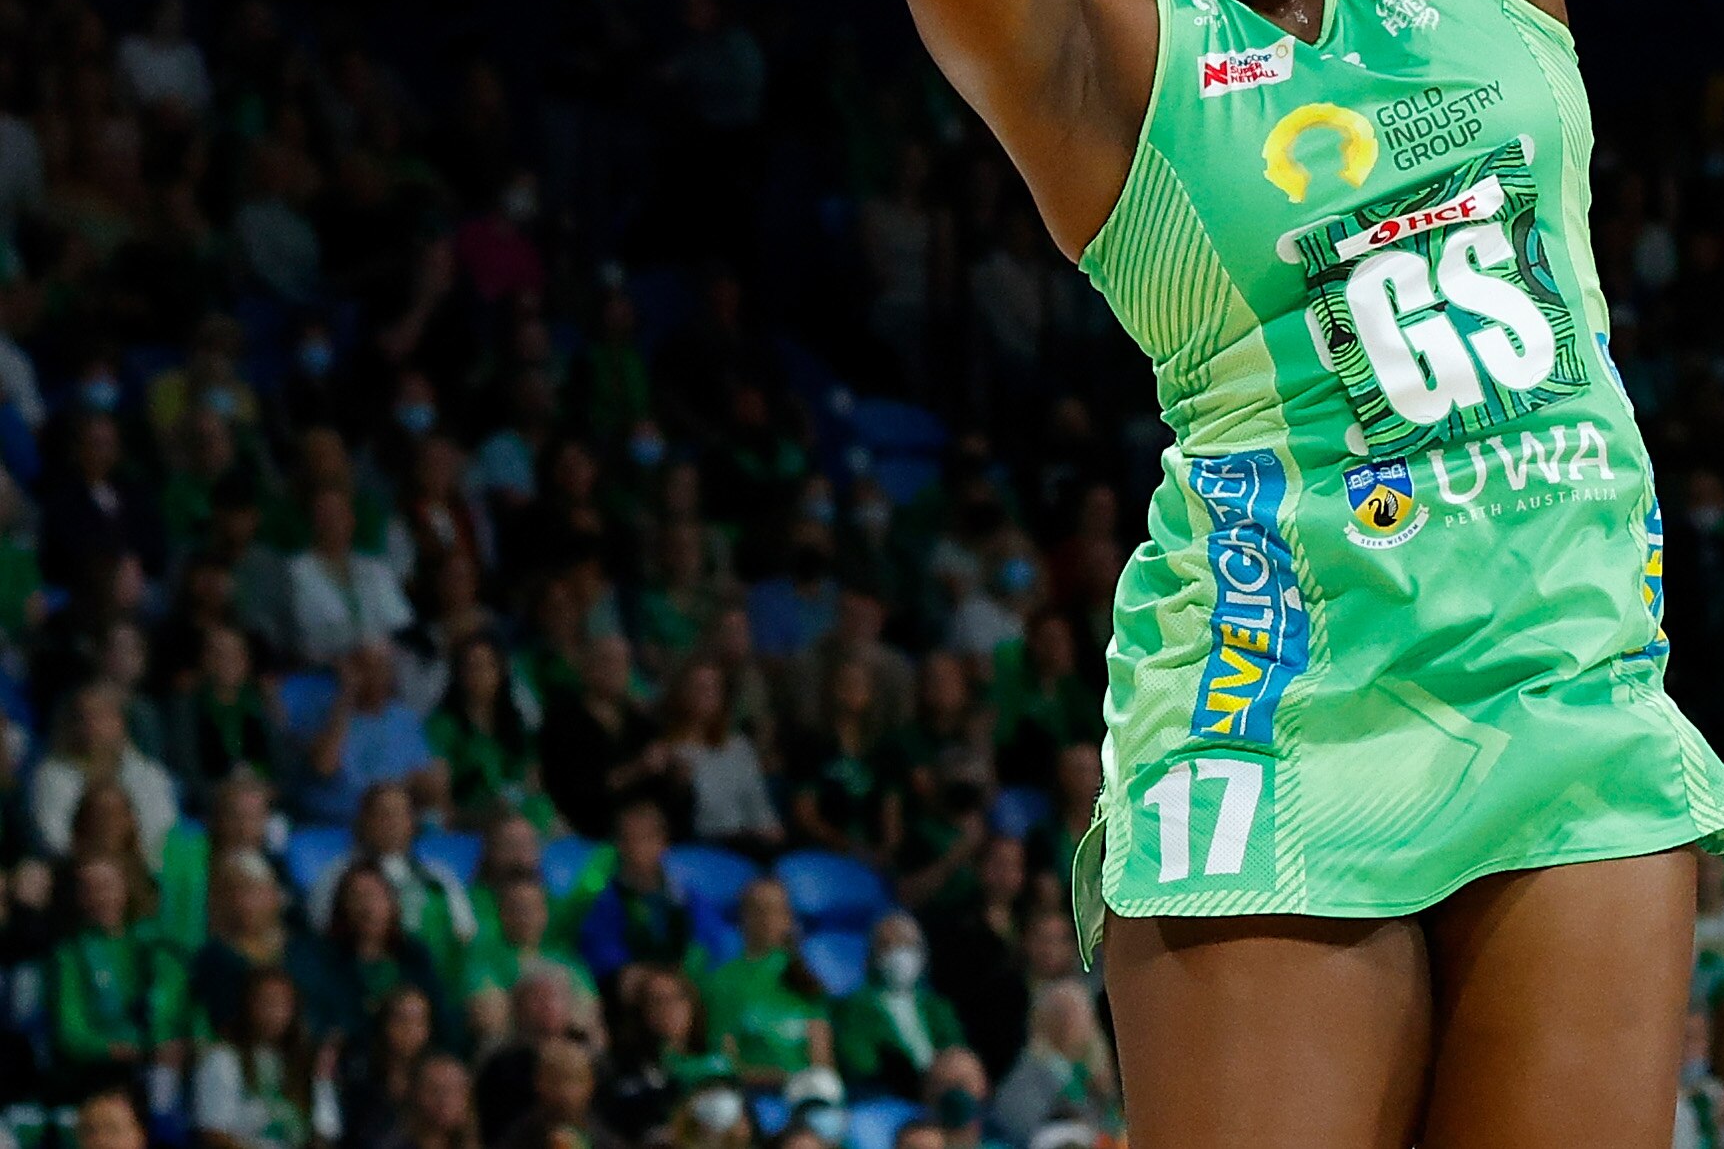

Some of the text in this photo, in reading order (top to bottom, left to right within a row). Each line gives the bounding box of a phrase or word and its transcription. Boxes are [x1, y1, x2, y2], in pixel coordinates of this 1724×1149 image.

[1230, 62, 1262, 74] SUPER
[1230, 70, 1278, 83] NETBALL
[1376, 86, 1443, 127] GOLD
[1384, 80, 1503, 150] INDUSTRY
[1393, 118, 1482, 171] GROUP
[1407, 196, 1477, 230] HCF
[1345, 222, 1555, 425] GS
[1426, 422, 1615, 504] UWA
[1445, 487, 1618, 527] PERTH AUSTRALIA
[1360, 523, 1418, 546] SEEK WISDOM
[1144, 758, 1263, 883] 17
